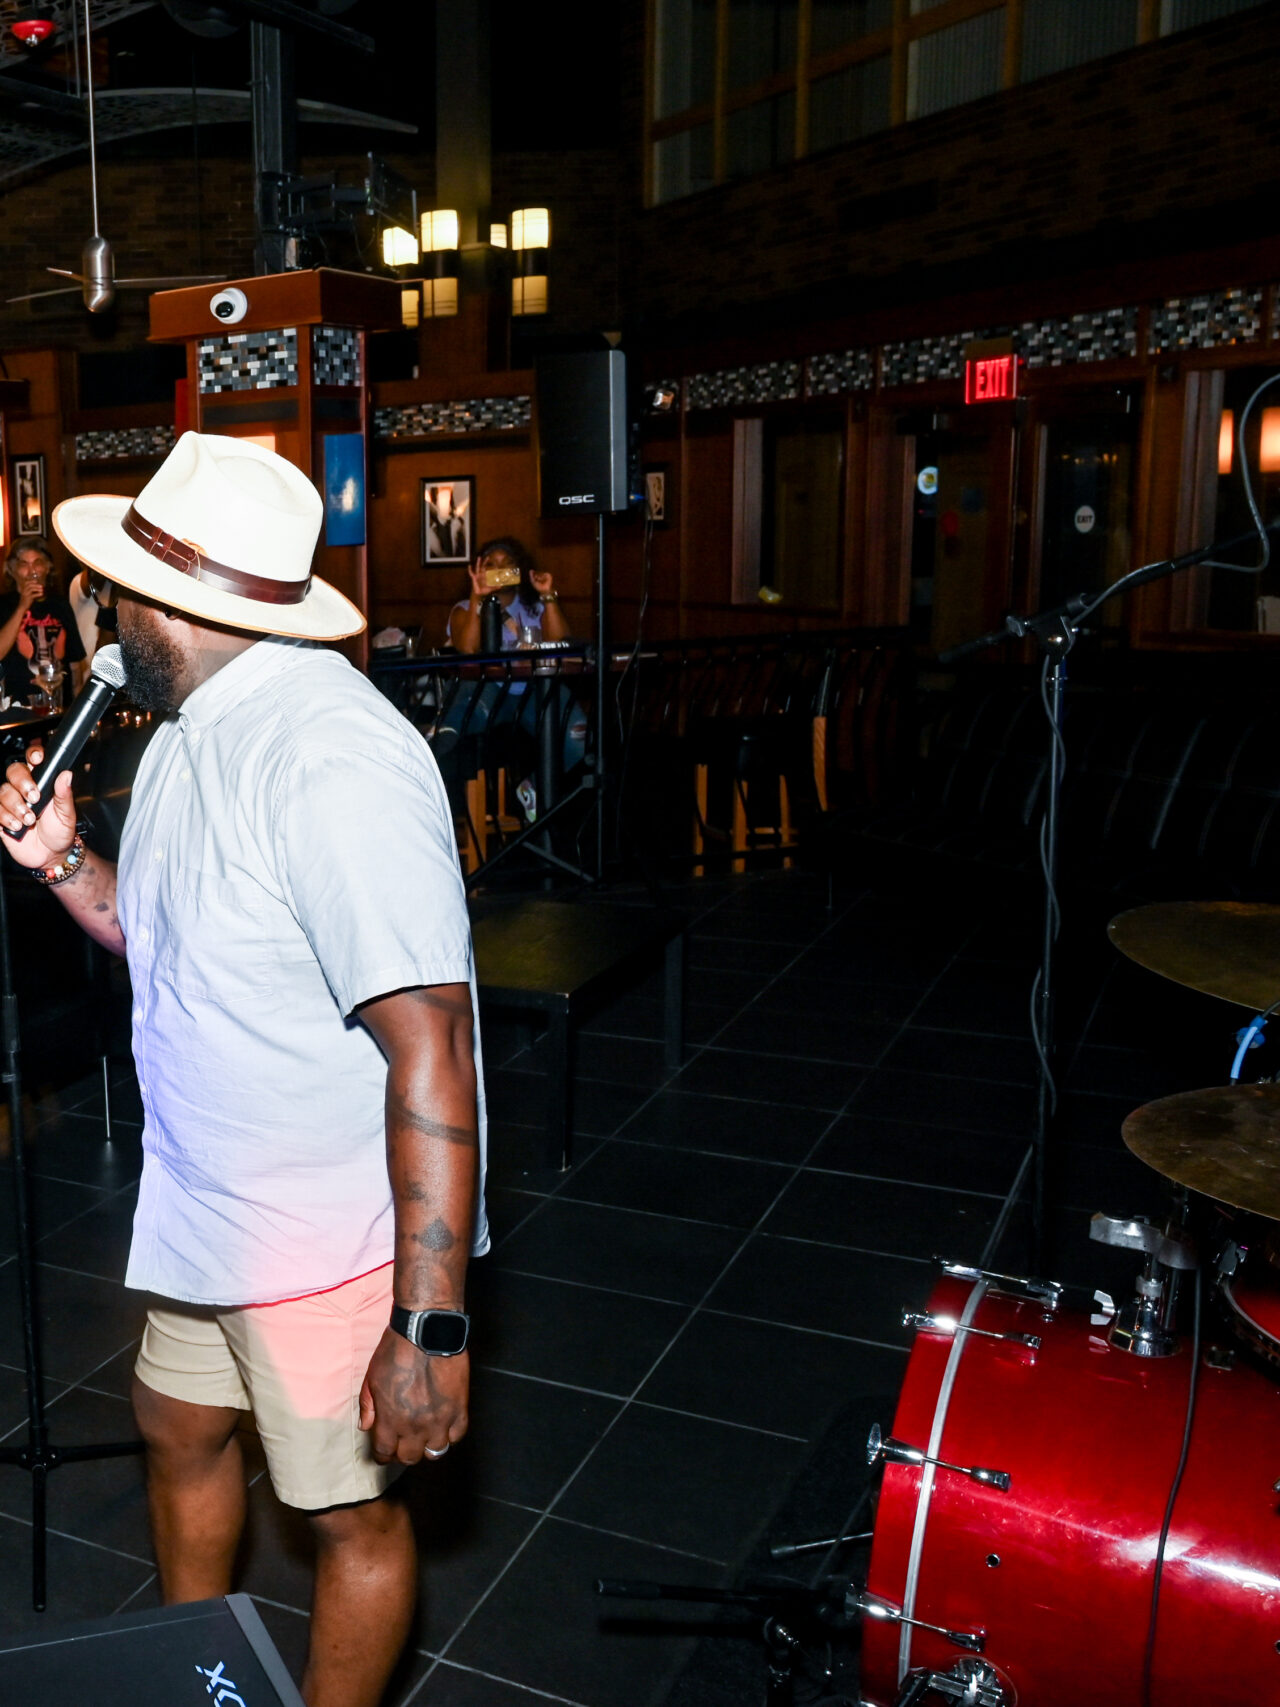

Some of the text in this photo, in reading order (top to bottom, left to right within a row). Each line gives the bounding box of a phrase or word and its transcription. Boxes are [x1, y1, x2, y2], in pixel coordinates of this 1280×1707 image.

[975, 357, 1010, 399] EXIT
[559, 494, 595, 505] QSC
[1077, 515, 1093, 523] EXIT
